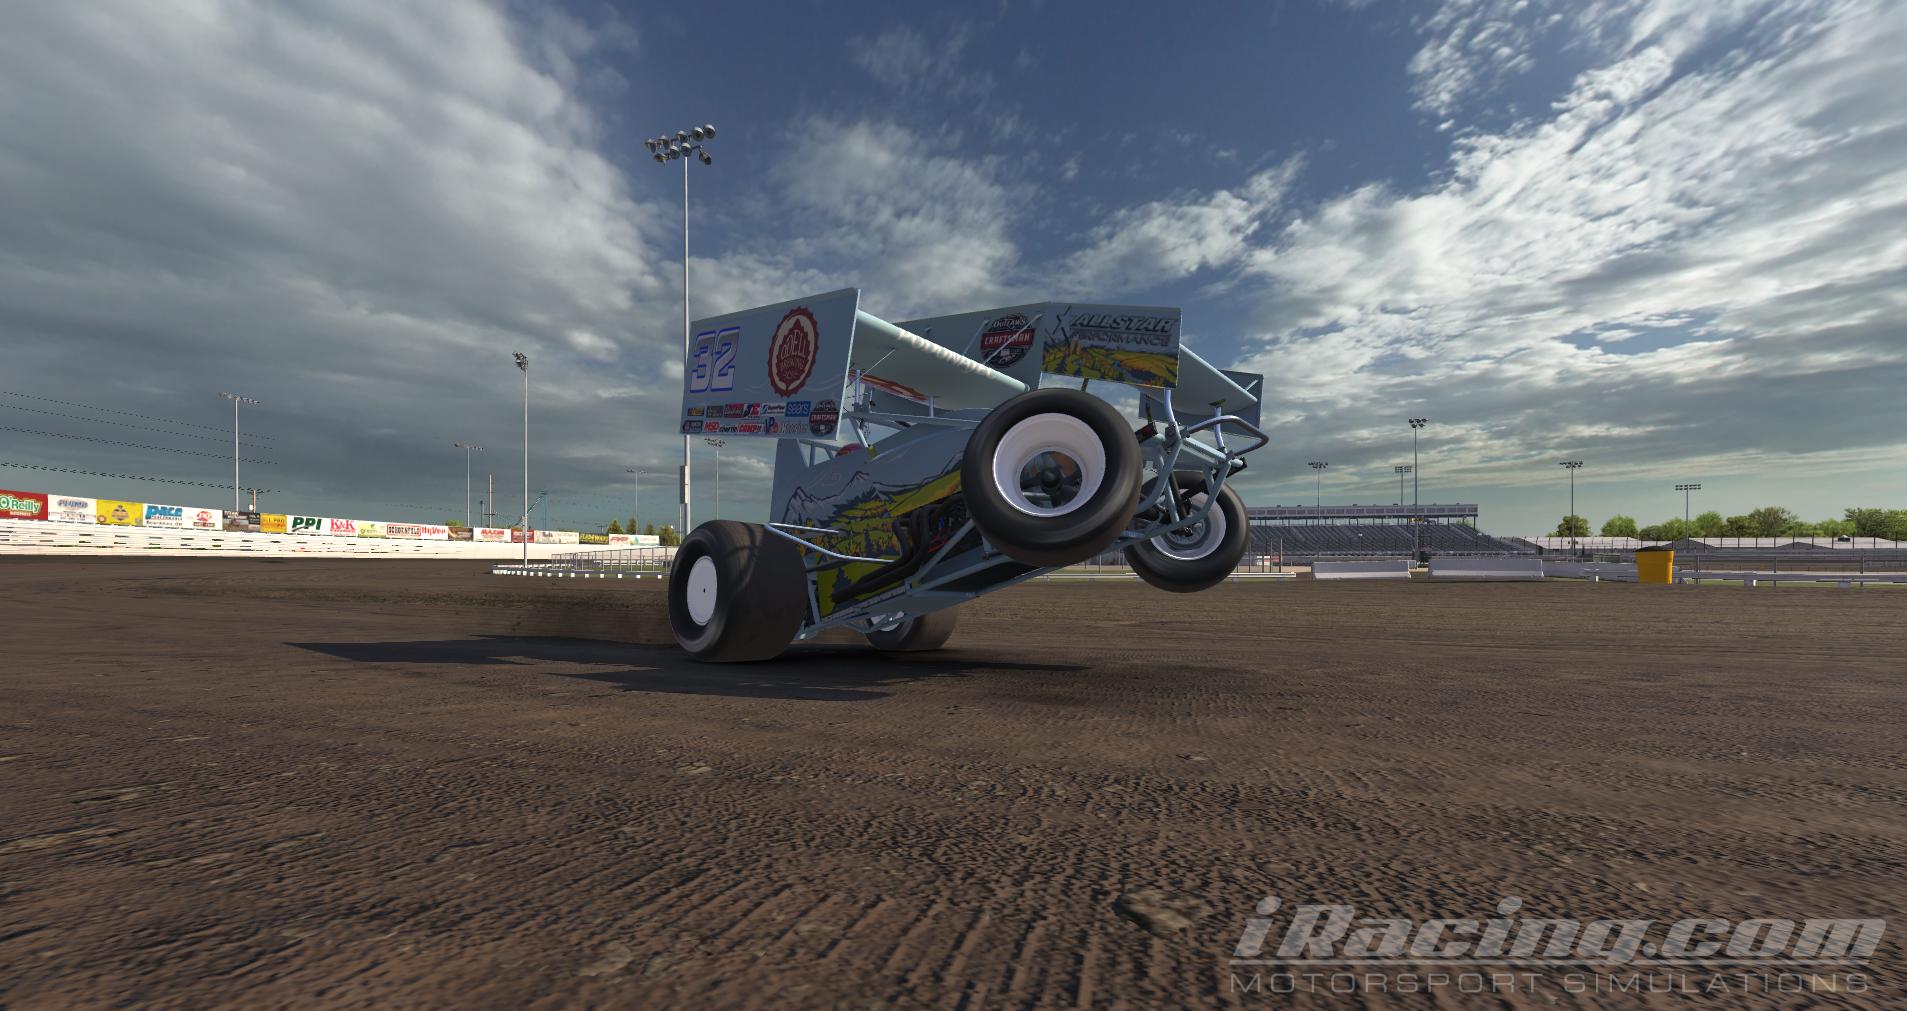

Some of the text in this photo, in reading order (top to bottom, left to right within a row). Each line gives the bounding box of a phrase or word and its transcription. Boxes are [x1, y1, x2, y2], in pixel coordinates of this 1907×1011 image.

[1072, 314, 1172, 333] ALLSTAR
[689, 326, 741, 393] 32
[0, 496, 41, 513] O'Reilly
[292, 517, 323, 530] PPI
[330, 518, 355, 530] K&K
